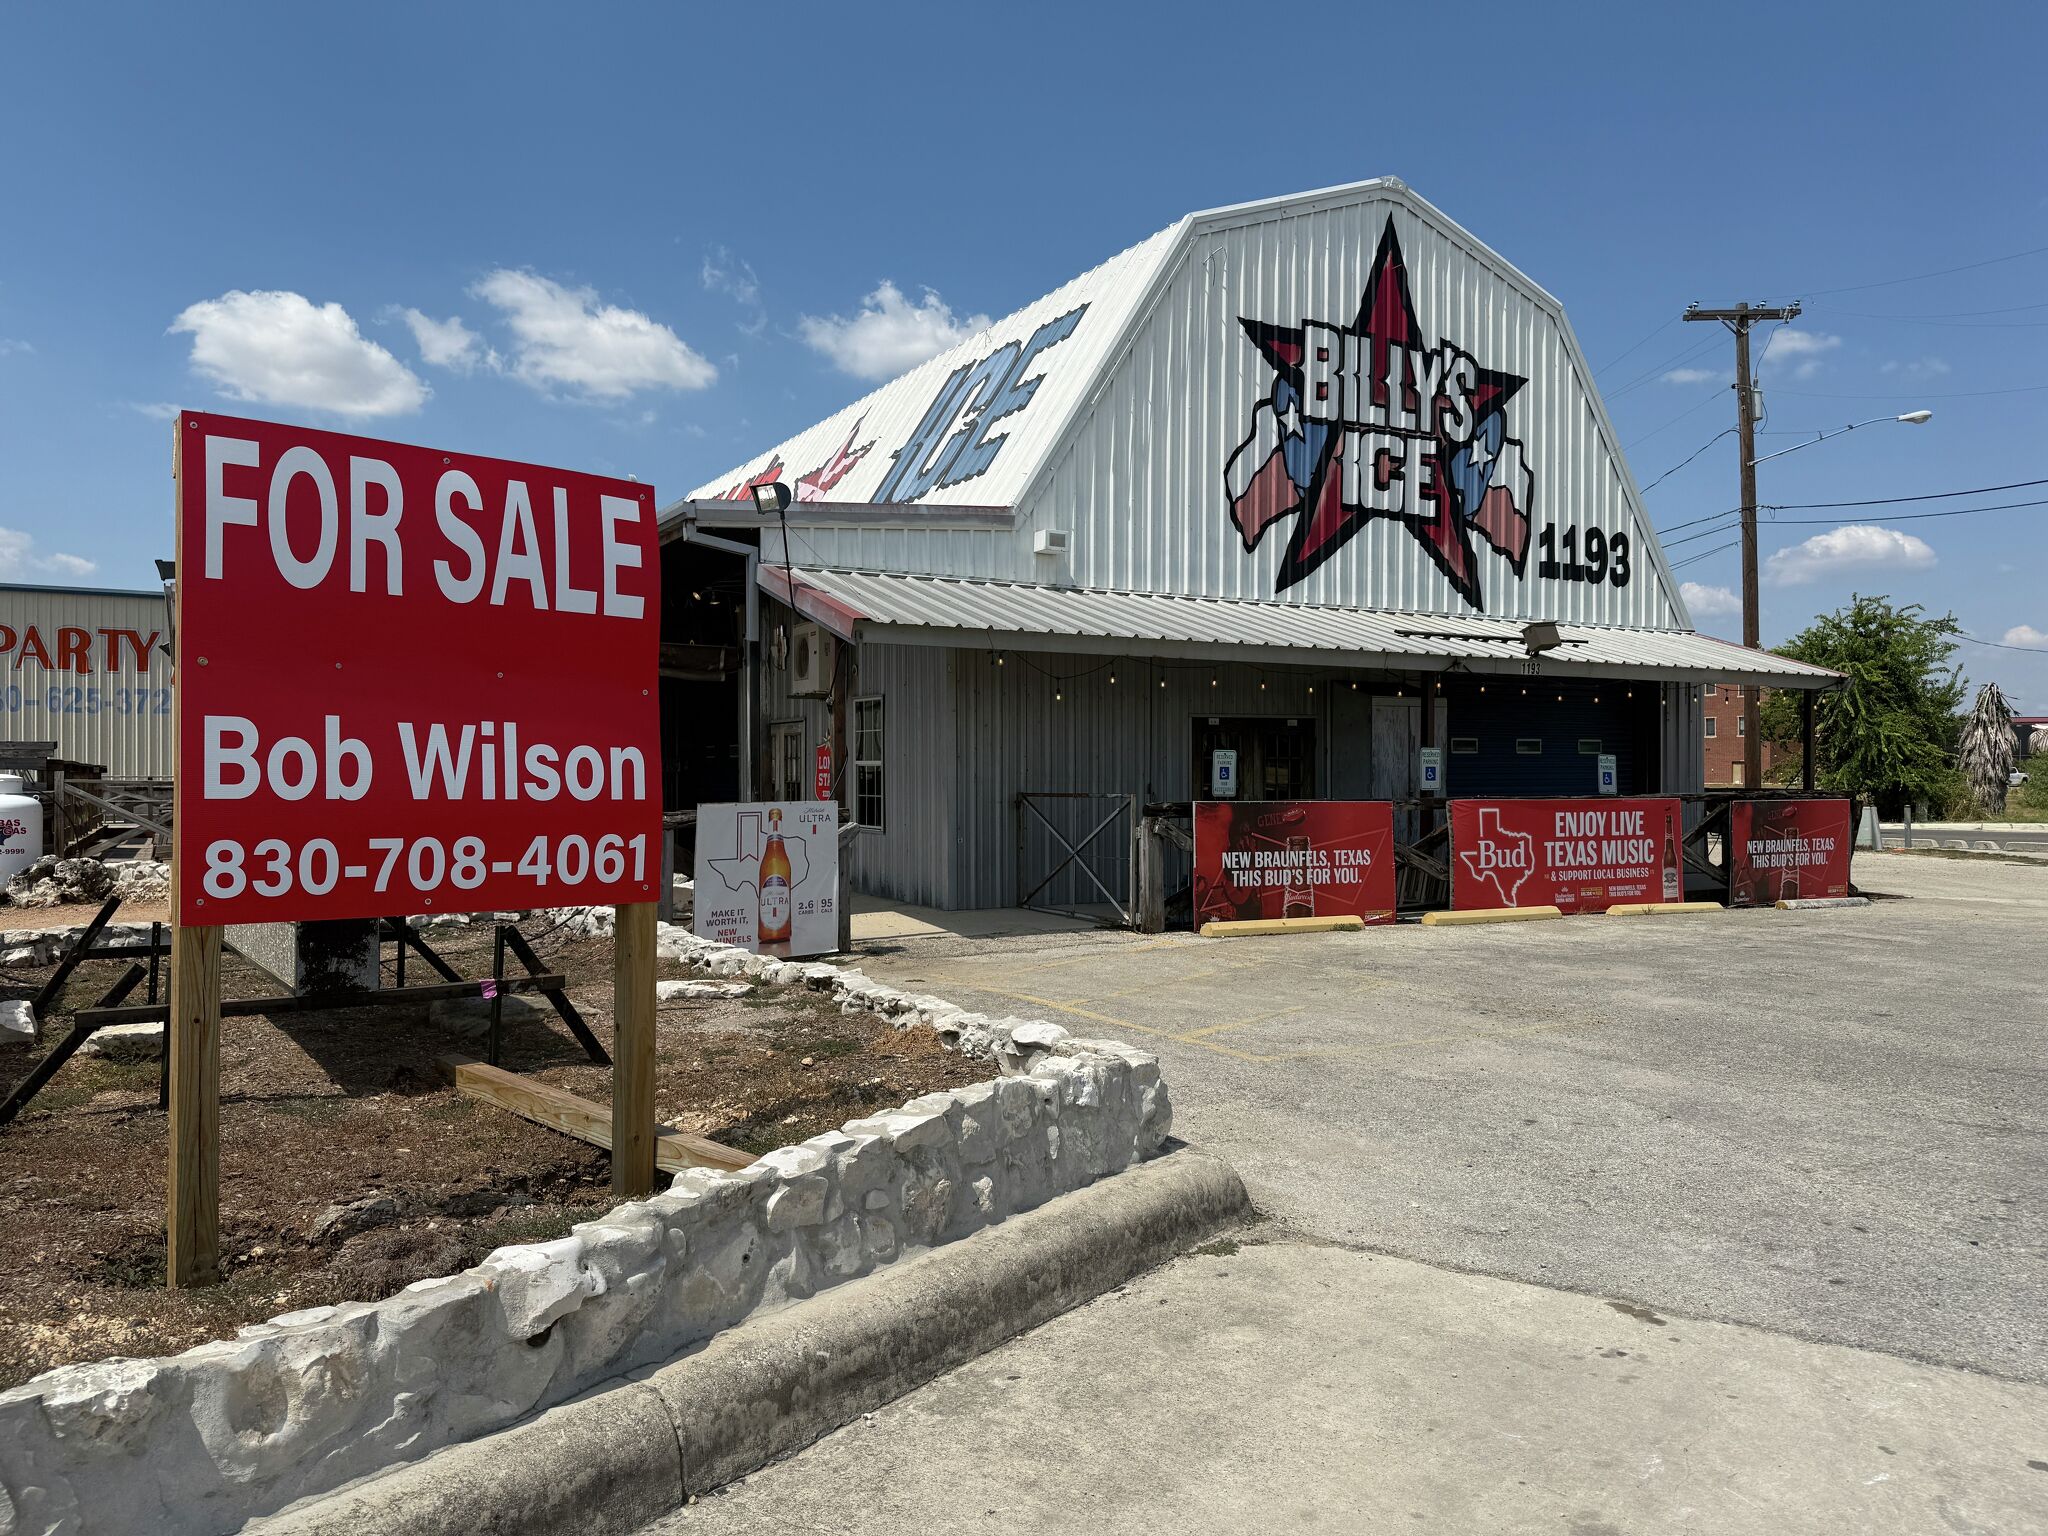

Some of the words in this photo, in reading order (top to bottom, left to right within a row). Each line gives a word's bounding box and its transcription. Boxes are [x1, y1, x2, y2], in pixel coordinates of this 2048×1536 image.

[1303, 320, 1478, 443] BILLY'S
[1337, 428, 1440, 519] ICE
[205, 434, 404, 597] FOR
[434, 470, 645, 620] SALE
[1538, 522, 1631, 588] 1193
[0, 624, 162, 675] PARTY
[1522, 662, 1541, 675] 1193
[0, 685, 170, 715] 0-625-372
[204, 715, 373, 801] Bob
[398, 721, 646, 802] Wilson
[799, 814, 831, 823] ULTRA
[1555, 811, 1607, 837] ENJOY
[1611, 811, 1644, 836] LIVE
[1478, 840, 1527, 868] Bud
[1544, 840, 1597, 866] TEXAS
[1602, 839, 1655, 865] MUSIC
[1747, 840, 1763, 854] NEW
[1766, 838, 1810, 853] BRAUNFELS,
[1812, 838, 1834, 850] TEXAS
[203, 833, 647, 900] 830-708-4061
[1222, 852, 1251, 869] NEW
[1255, 850, 1331, 868] BRAUNFELS,
[1334, 849, 1371, 866] TEXAS
[1752, 855, 1770, 869] THIS
[1771, 854, 1793, 867] BUD'S
[1795, 853, 1810, 866] FOR
[1811, 852, 1828, 865] YOU.
[1232, 870, 1261, 887] THIS
[1265, 869, 1303, 886] BUD'S
[1307, 868, 1330, 885] FOR
[1334, 867, 1362, 884] YOU.
[1551, 871, 1557, 881] &
[1558, 869, 1592, 881] SUPPORT
[1593, 868, 1615, 879] LOCAL
[1616, 867, 1649, 878] BUSINESS
[761, 897, 789, 906] ULTRA
[798, 900, 814, 909] 2.6
[821, 898, 832, 908] 95
[706, 918, 737, 927] WORTH
[711, 909, 735, 918] MAKE
[737, 908, 744, 916] IT
[718, 928, 737, 937] NEW
